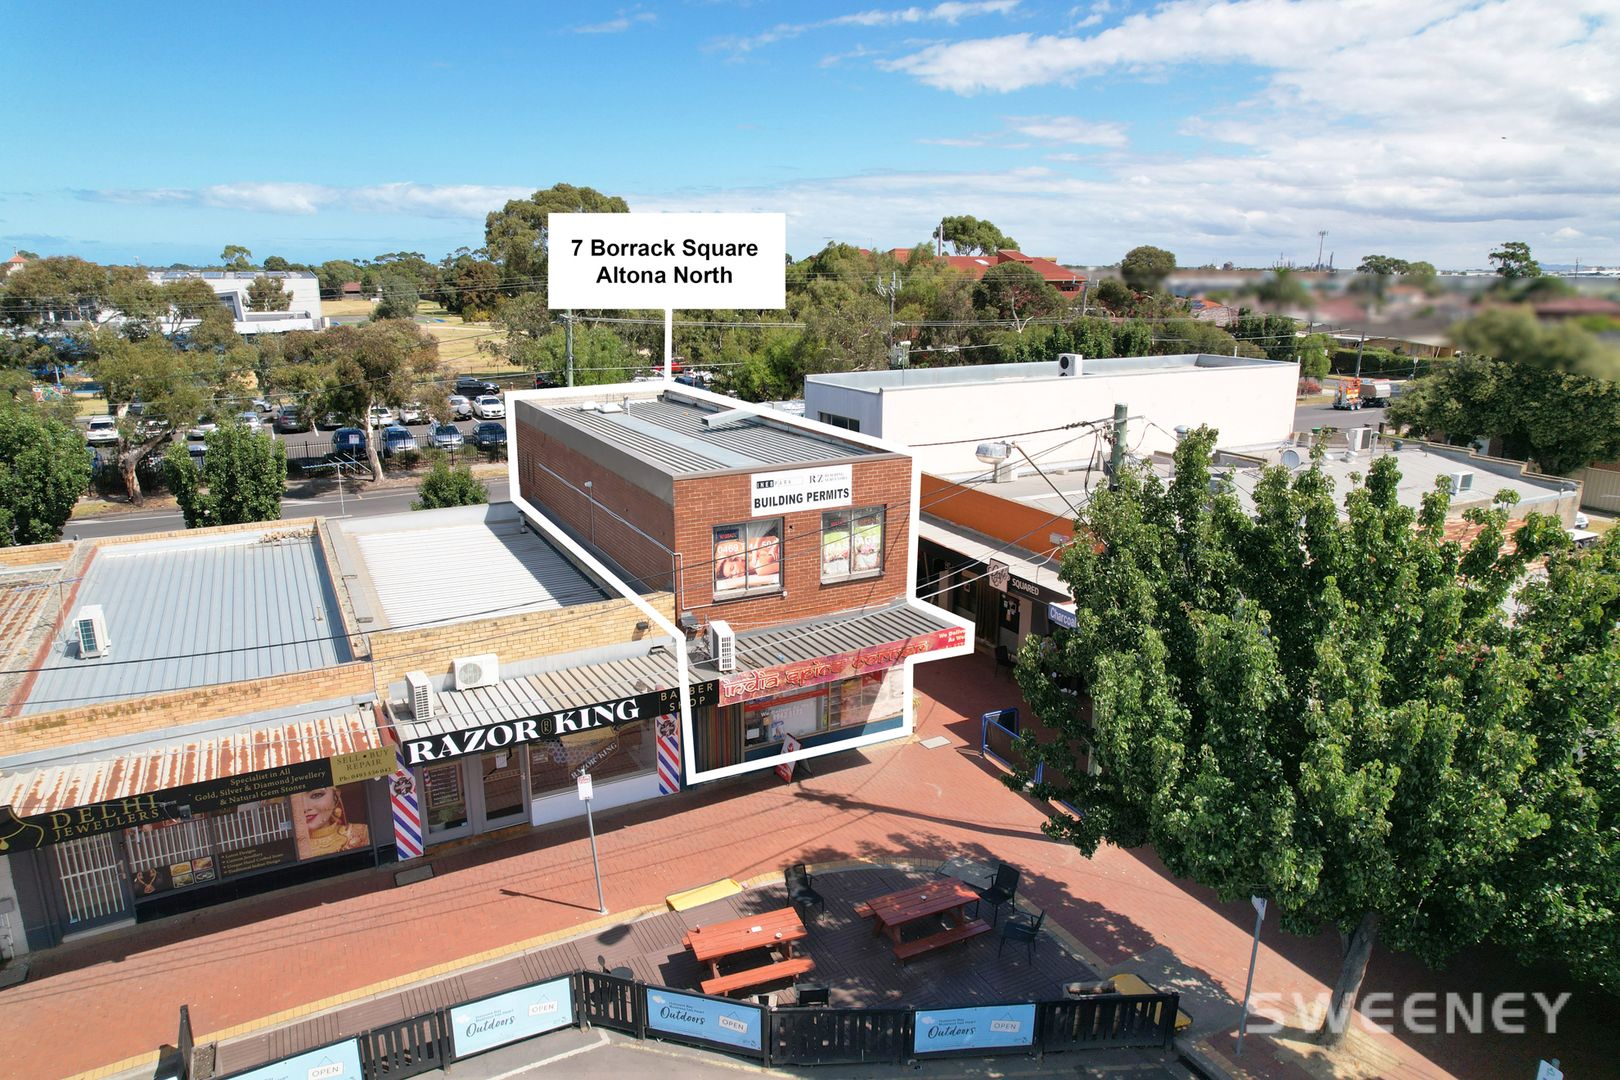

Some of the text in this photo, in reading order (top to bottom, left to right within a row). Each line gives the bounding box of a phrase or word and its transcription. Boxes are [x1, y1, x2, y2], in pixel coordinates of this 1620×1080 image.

[754, 488, 850, 509] BUILDING PERMITS
[1012, 578, 1040, 596] SQUARED
[1050, 607, 1077, 628] Charcoal
[723, 670, 779, 698] india
[784, 659, 848, 687] spice
[660, 682, 713, 701] BABER
[407, 719, 541, 764] RAZOR
[553, 698, 640, 735] KING
[336, 749, 389, 765] SELL BUY
[598, 742, 618, 759] KING
[346, 759, 382, 771] REPAIR
[194, 770, 326, 802] Gold, Silver & Diamond Jewellery
[230, 773, 268, 787] Specialist
[280, 768, 291, 776] All
[228, 791, 259, 804] Natural
[260, 788, 280, 798] Gem
[280, 783, 306, 794] Stones
[51, 793, 157, 830] DELHI
[54, 808, 160, 842] JEWELLERS
[531, 1004, 555, 1013] OPEN
[660, 1006, 705, 1025] Outdoors
[466, 1015, 515, 1038] Outdoors
[721, 1018, 744, 1030] OPEN
[928, 1025, 976, 1039] Outdoors
[993, 1022, 1017, 1030] OPEN
[311, 1065, 339, 1077] OPEN
